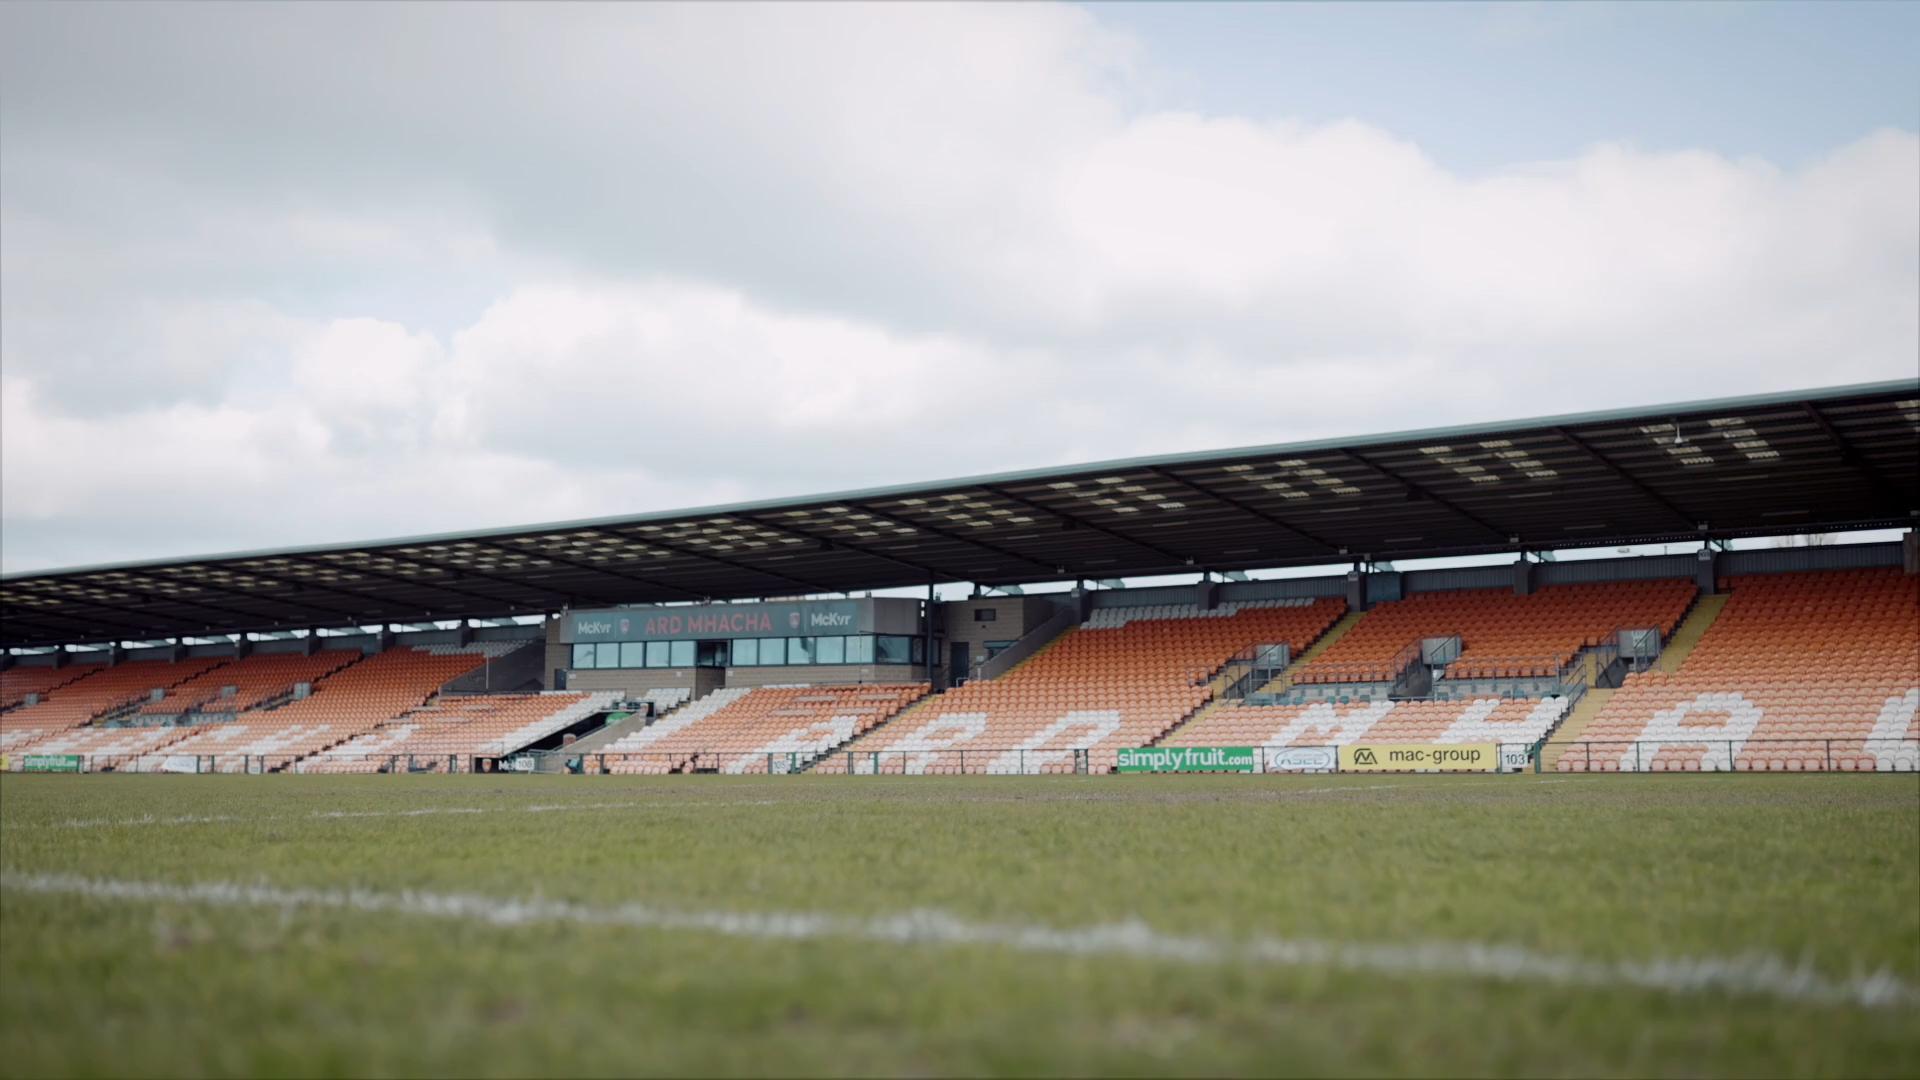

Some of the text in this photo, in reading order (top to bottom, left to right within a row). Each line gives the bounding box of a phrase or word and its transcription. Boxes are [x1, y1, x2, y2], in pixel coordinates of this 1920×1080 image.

[645, 611, 772, 635] ARD MHACHA
[1118, 748, 1252, 770] simplyfruit.com
[1389, 749, 1481, 764] mac-group
[1505, 754, 1525, 765] 103
